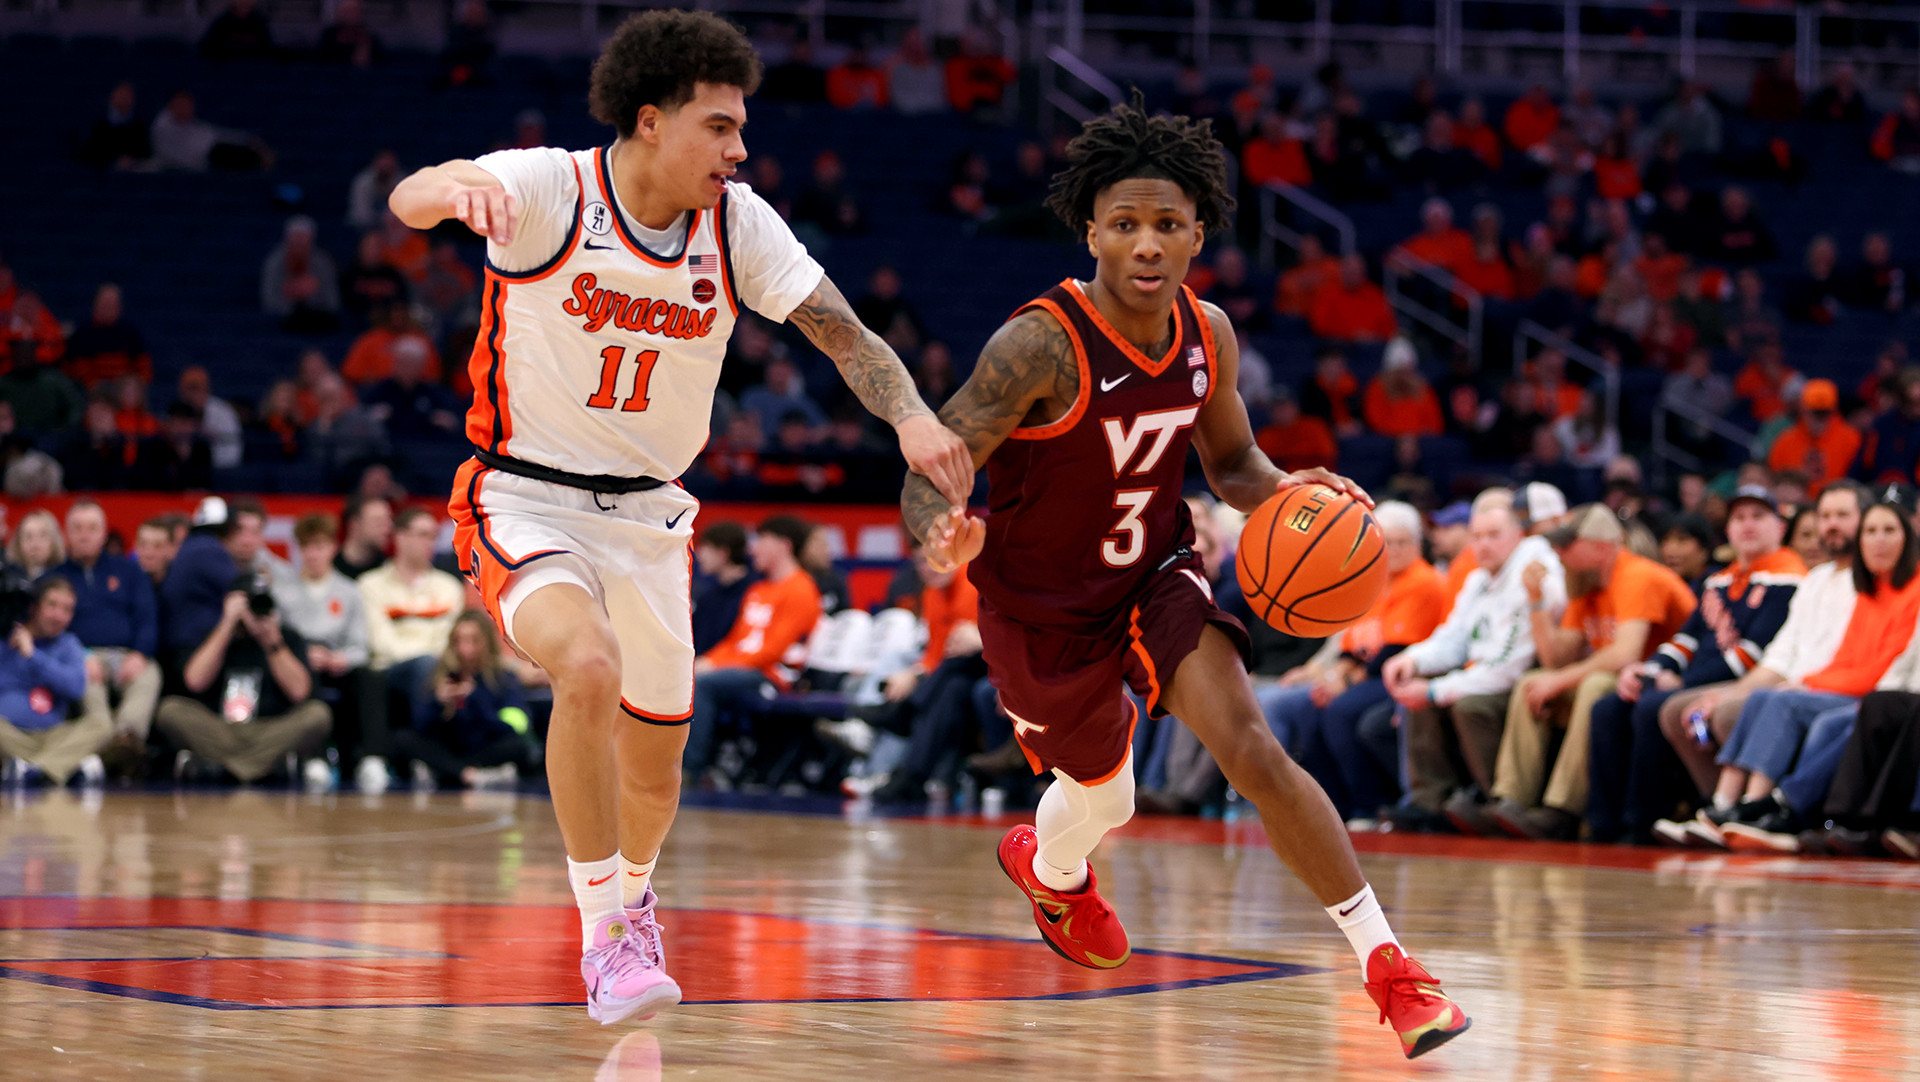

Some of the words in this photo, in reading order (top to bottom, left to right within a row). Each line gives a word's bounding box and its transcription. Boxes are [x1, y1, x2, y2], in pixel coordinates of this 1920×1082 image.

[592, 216, 603, 231] 21
[594, 205, 605, 216] LM
[563, 273, 717, 339] Syracuse
[587, 345, 660, 412] 11
[1101, 403, 1200, 478] VT
[1101, 487, 1158, 568] 3
